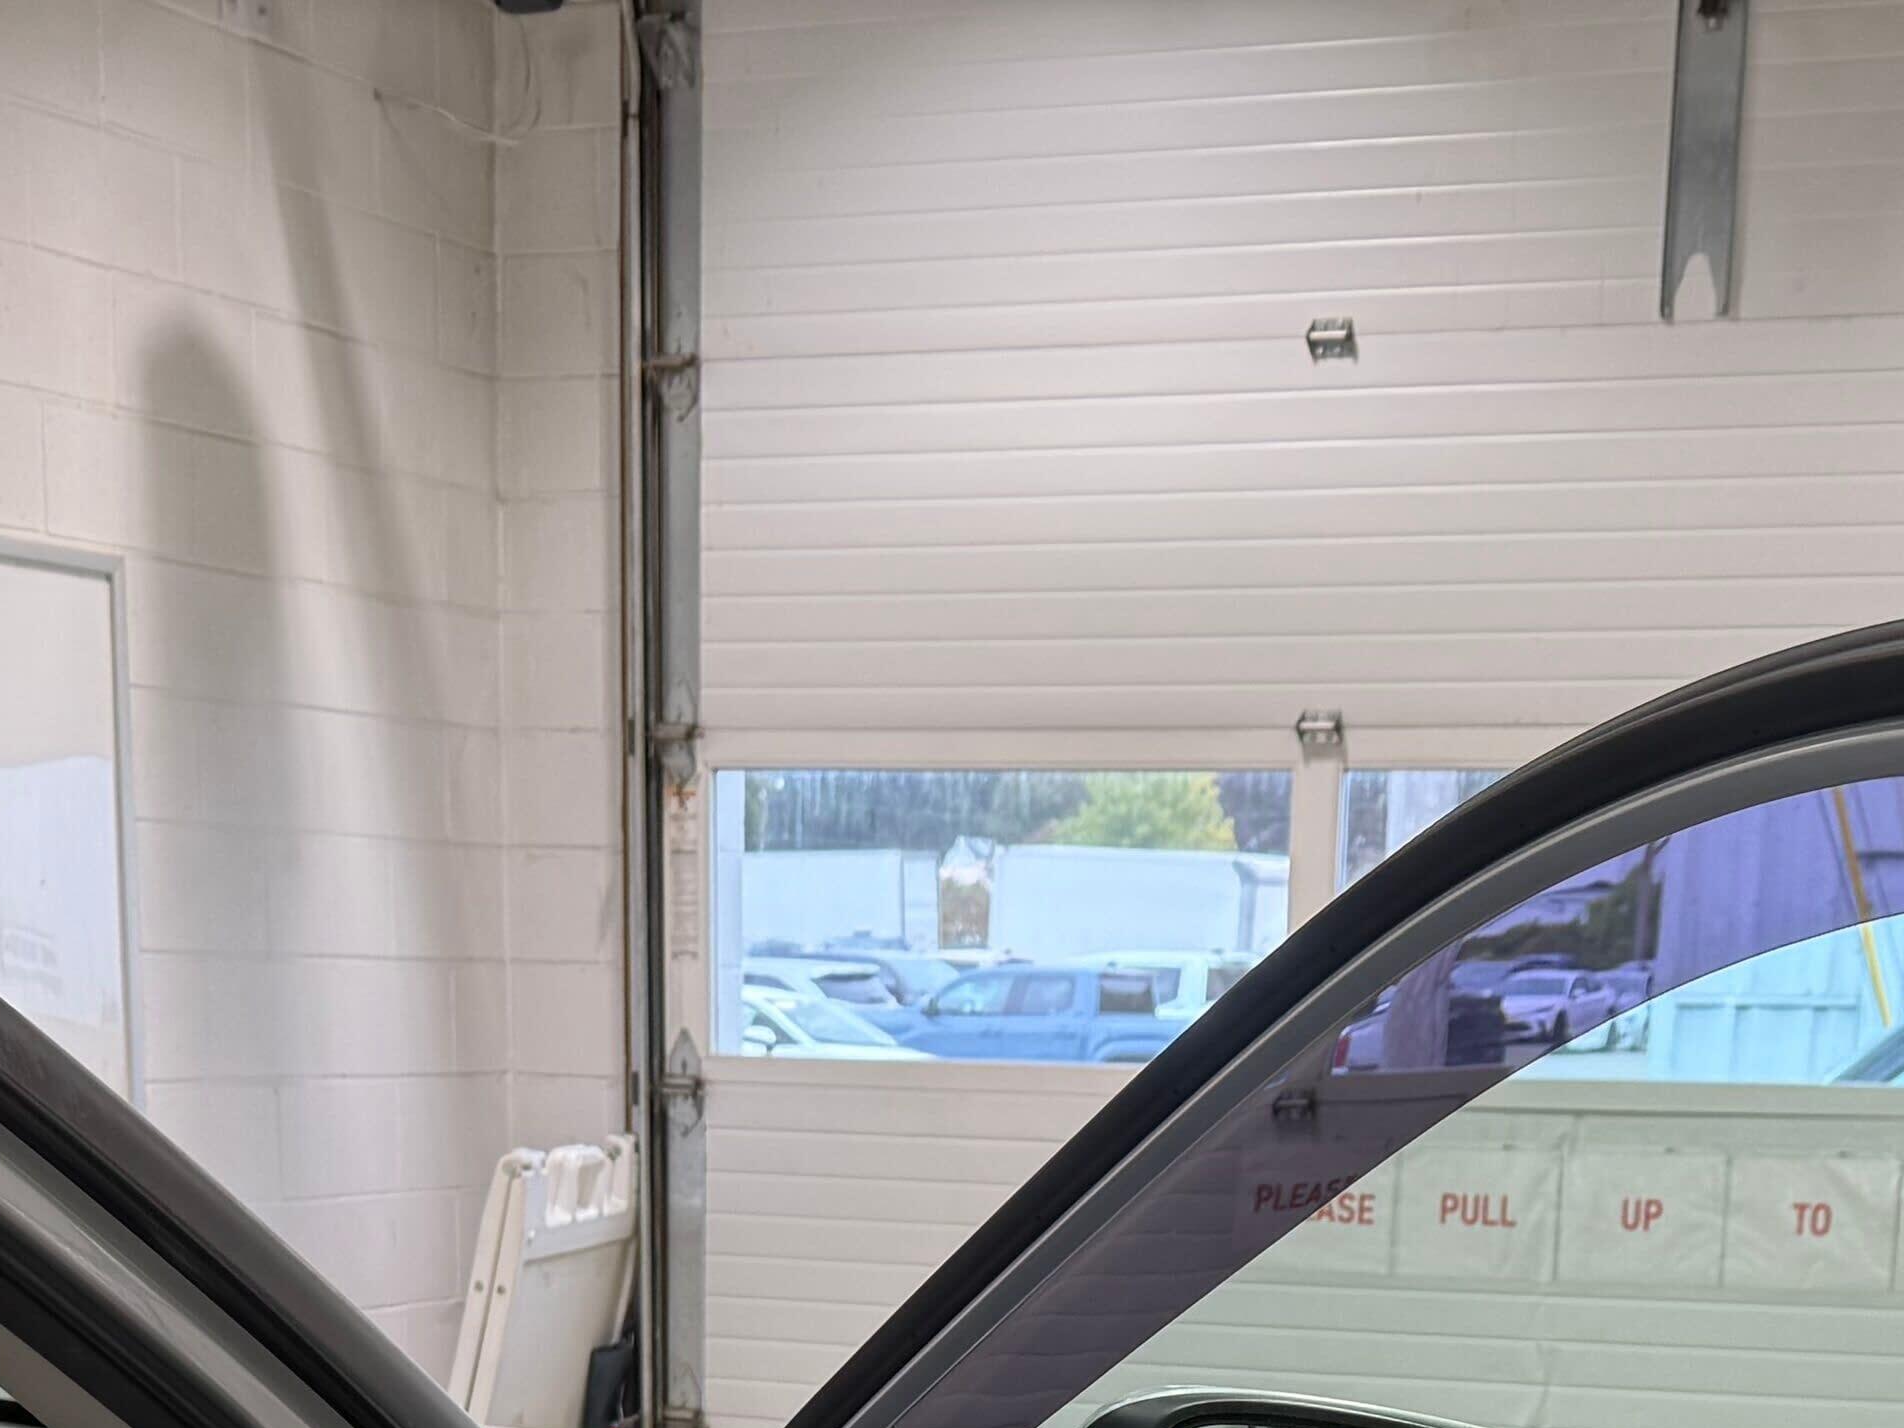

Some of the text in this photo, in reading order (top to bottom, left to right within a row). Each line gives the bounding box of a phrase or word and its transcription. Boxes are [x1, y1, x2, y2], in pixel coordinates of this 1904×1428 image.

[1253, 1174, 1376, 1226] PLEASE
[1439, 1192, 1517, 1228] PULL
[1620, 1197, 1663, 1232] UP
[1793, 1201, 1833, 1237] TO
